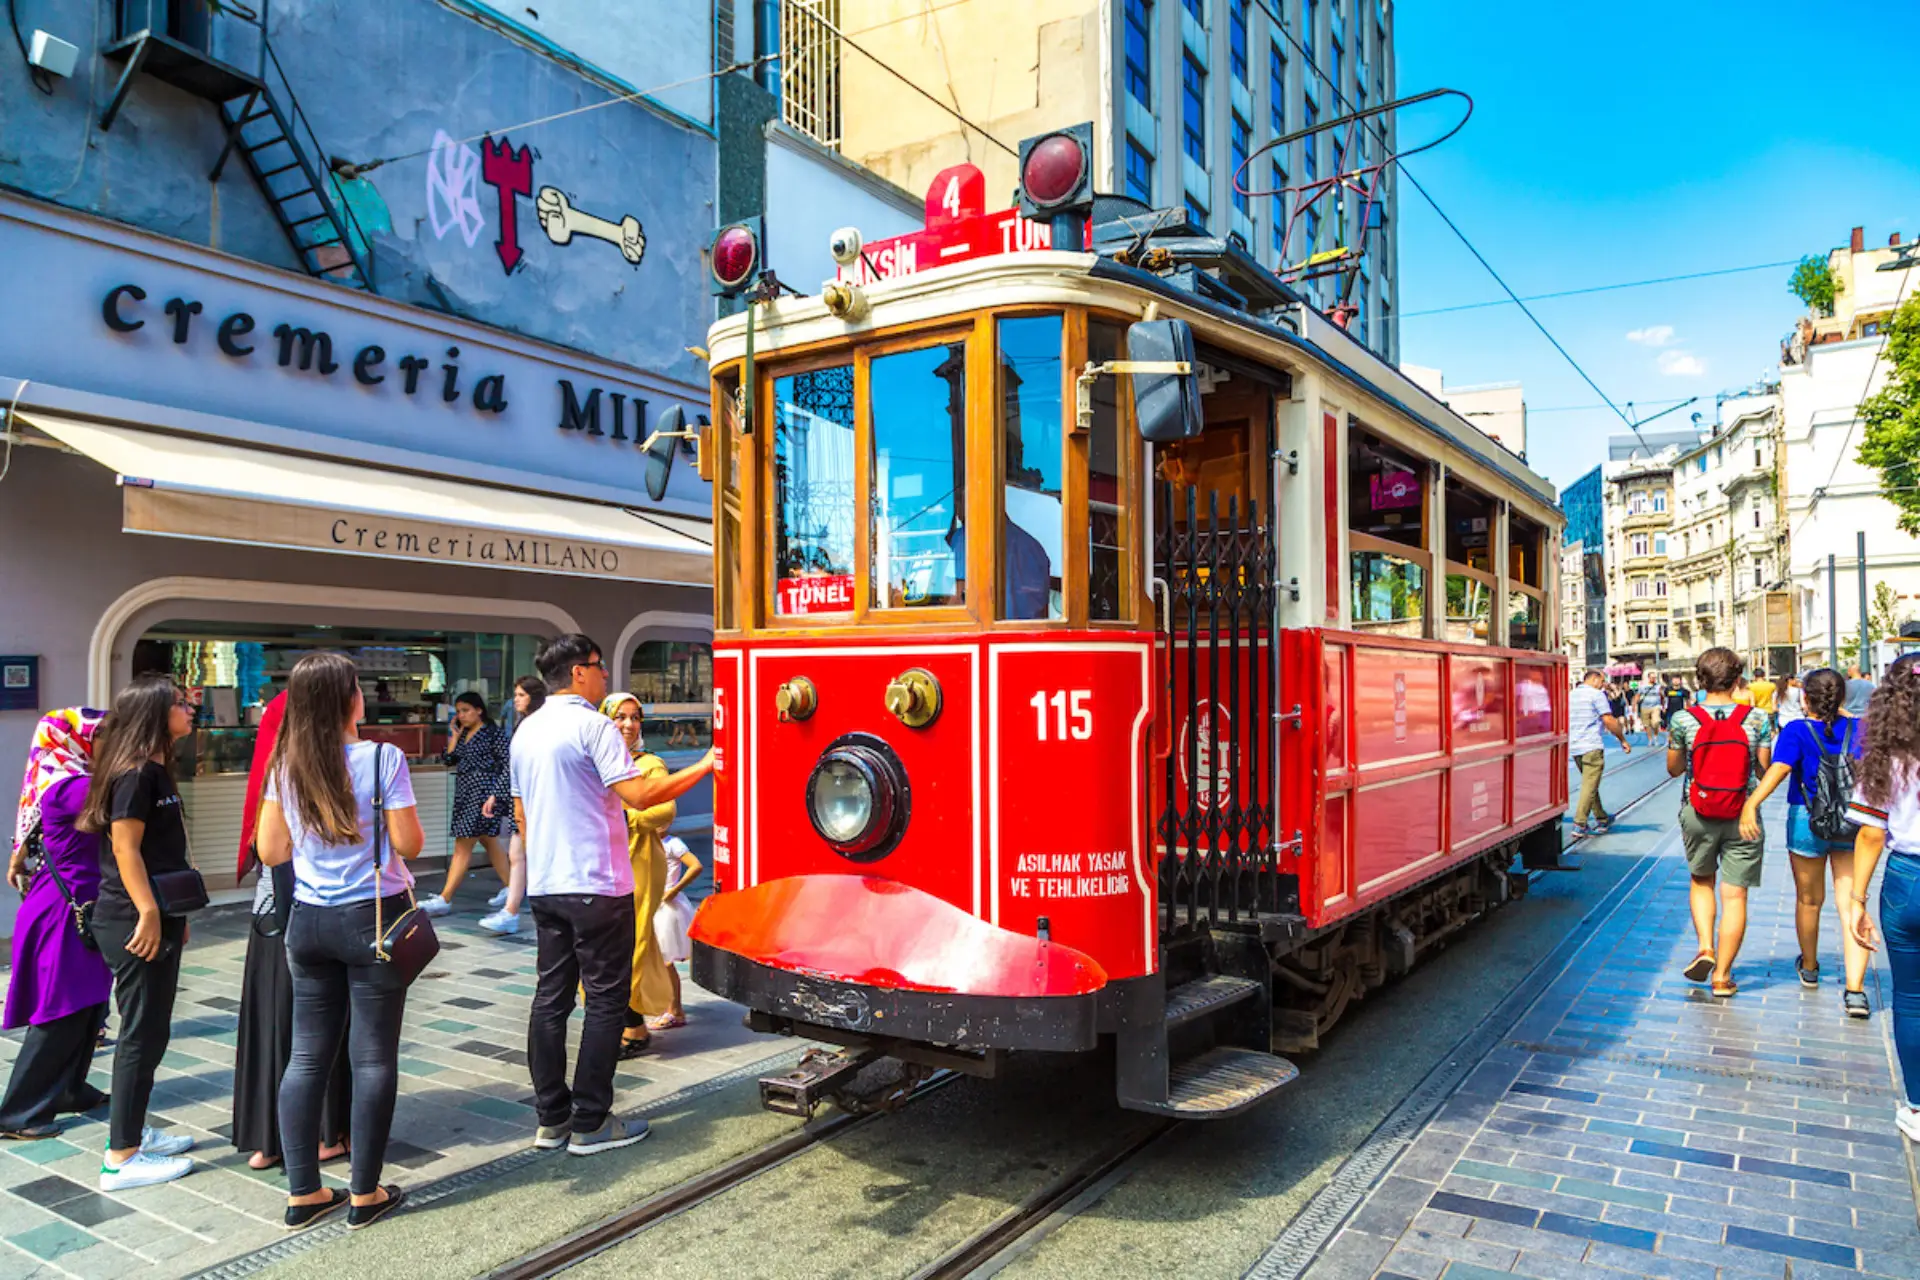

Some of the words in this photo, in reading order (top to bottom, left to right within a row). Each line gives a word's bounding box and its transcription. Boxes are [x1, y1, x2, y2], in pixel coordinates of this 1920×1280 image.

[943, 175, 960, 218] 4
[841, 239, 917, 286] AKSİM
[331, 518, 495, 560] Cremeria
[504, 538, 619, 572] MILANO
[787, 584, 850, 604] TÜNEL
[1029, 689, 1092, 741] 115
[1088, 851, 1127, 872] YASAK
[1010, 877, 1031, 897] VE
